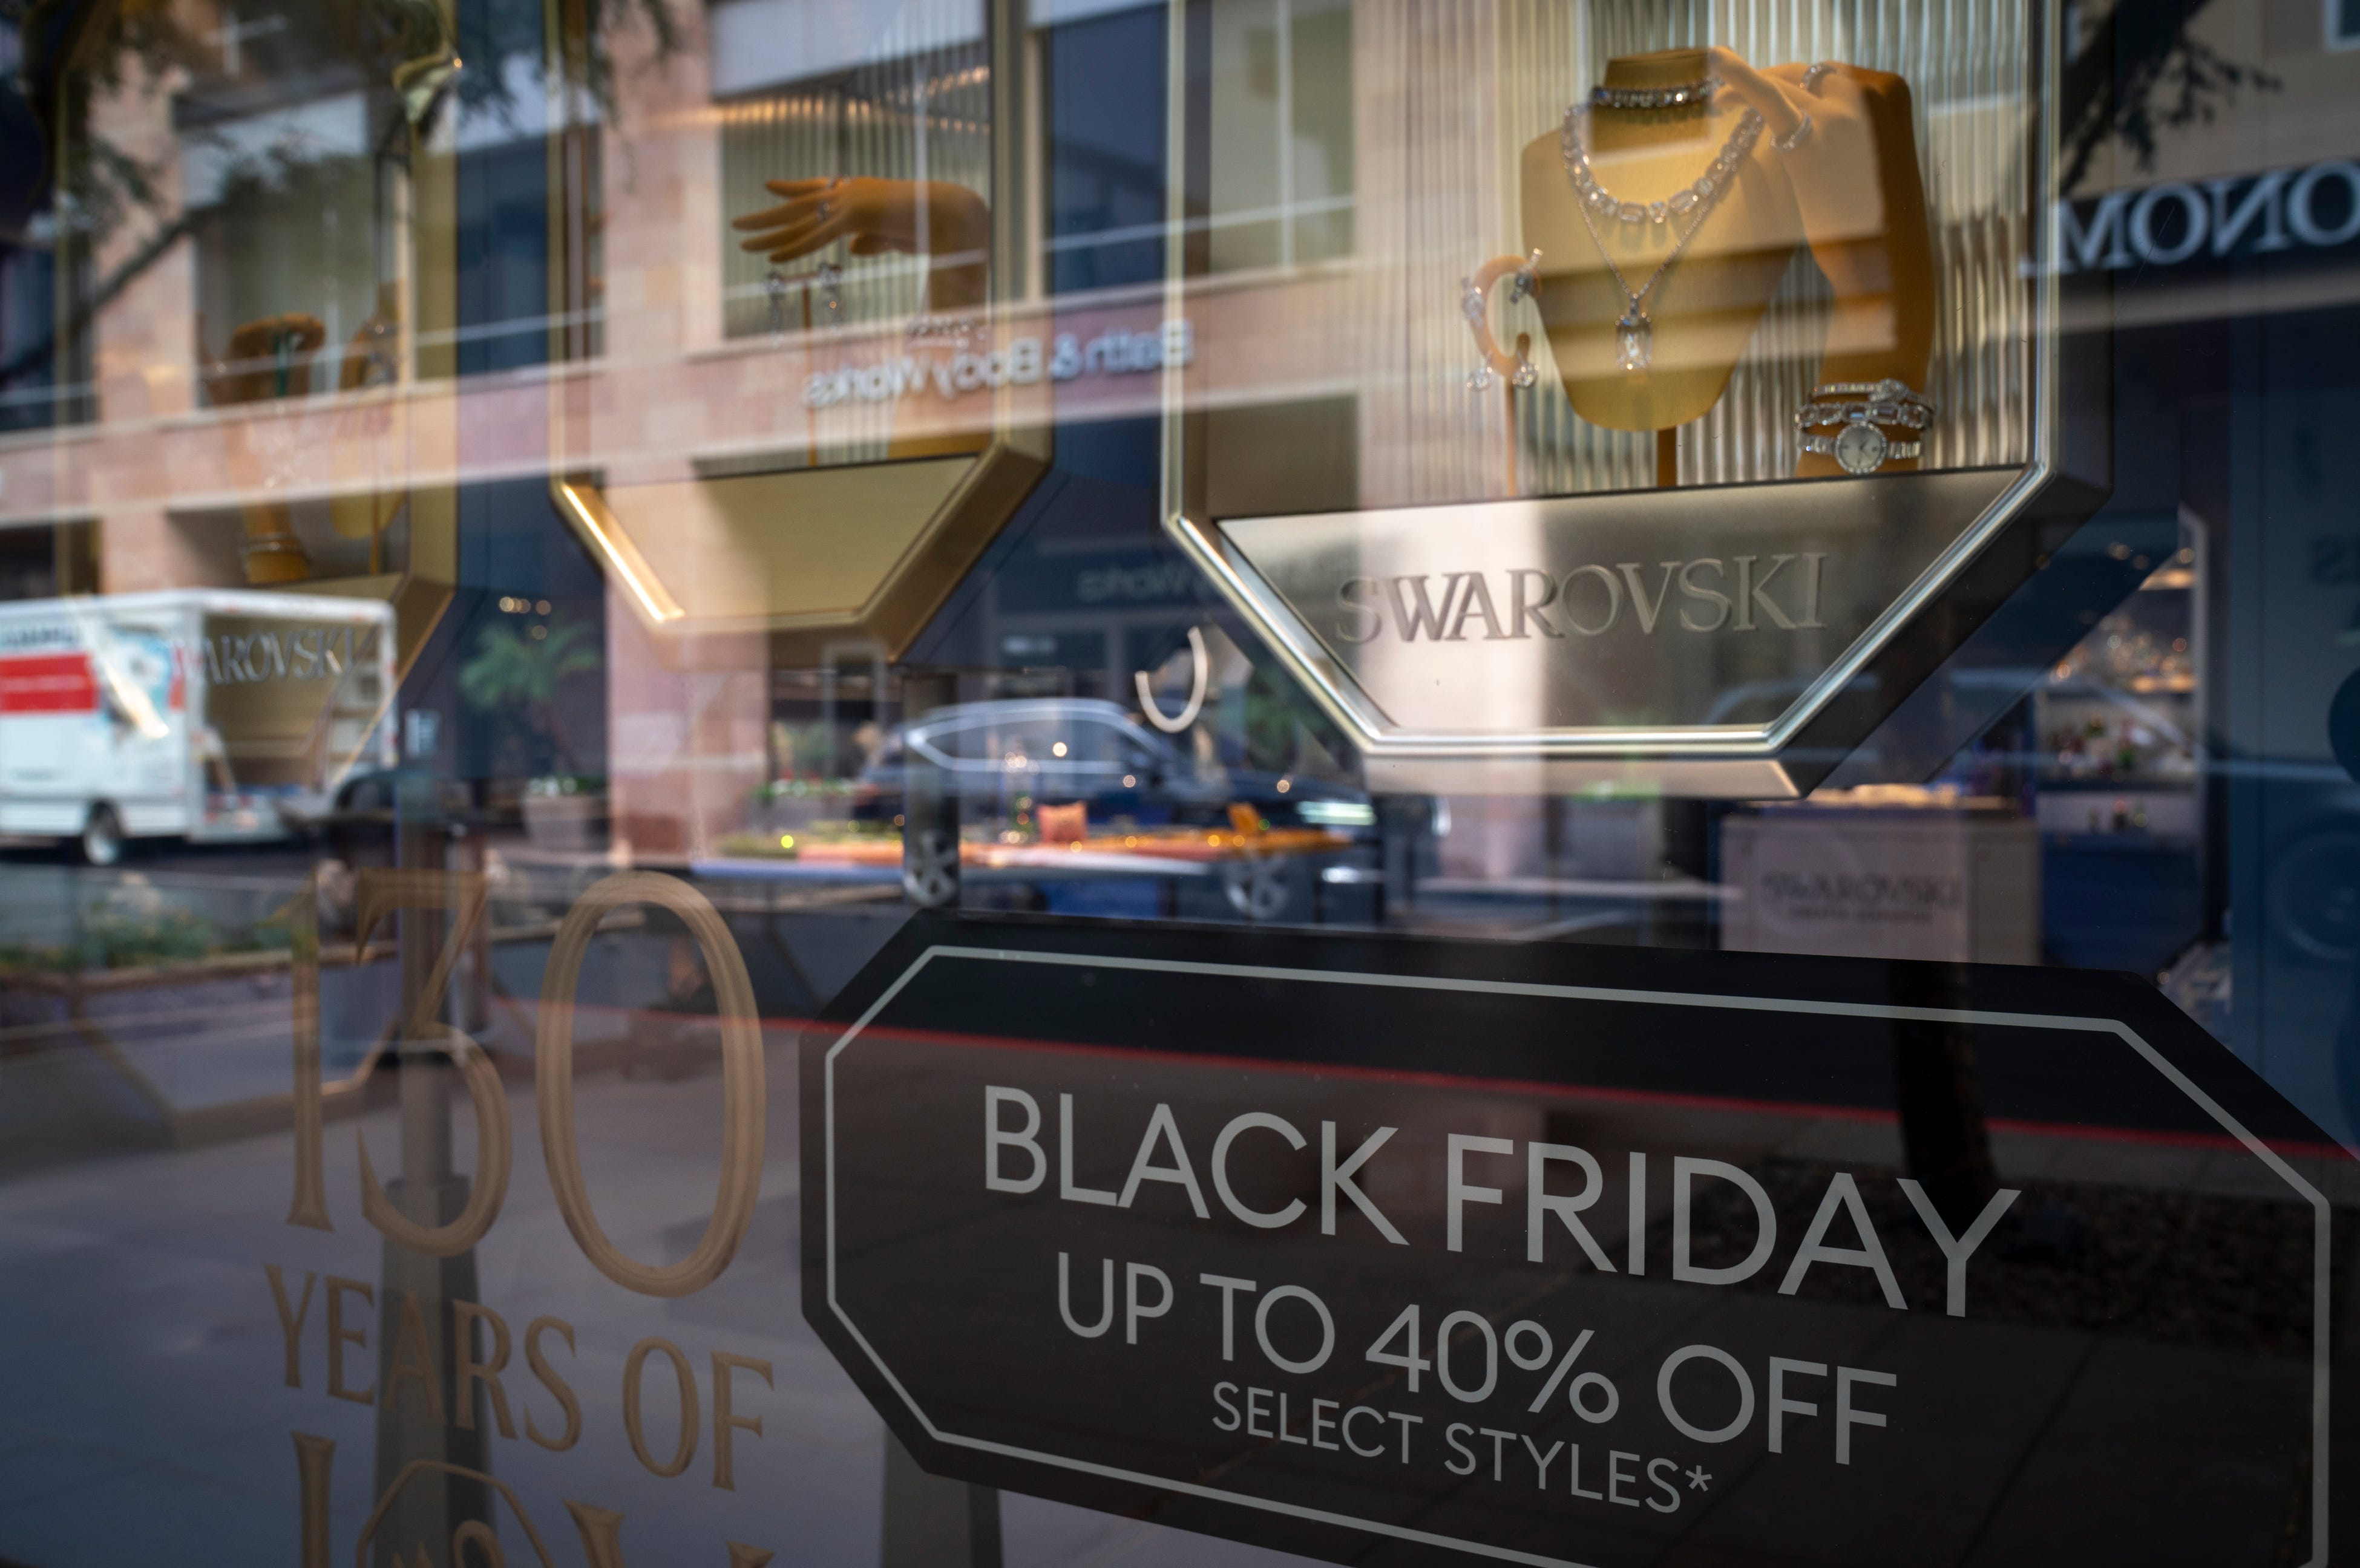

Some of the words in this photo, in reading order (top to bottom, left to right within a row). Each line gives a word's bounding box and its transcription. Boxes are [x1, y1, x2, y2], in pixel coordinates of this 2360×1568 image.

[1335, 552, 1828, 645] SWAROVSKI
[269, 869, 765, 1298] 130
[984, 1085, 1410, 1246] BLACK
[1447, 1133, 2022, 1318] FRIDAY
[263, 1262, 582, 1452] YEARS
[622, 1336, 775, 1491] OF
[1057, 1251, 1174, 1345] UP
[1199, 1272, 1336, 1374] TO
[1365, 1304, 1619, 1424] 40%
[1656, 1344, 1897, 1465] OFF
[1211, 1381, 1424, 1465] SELECT
